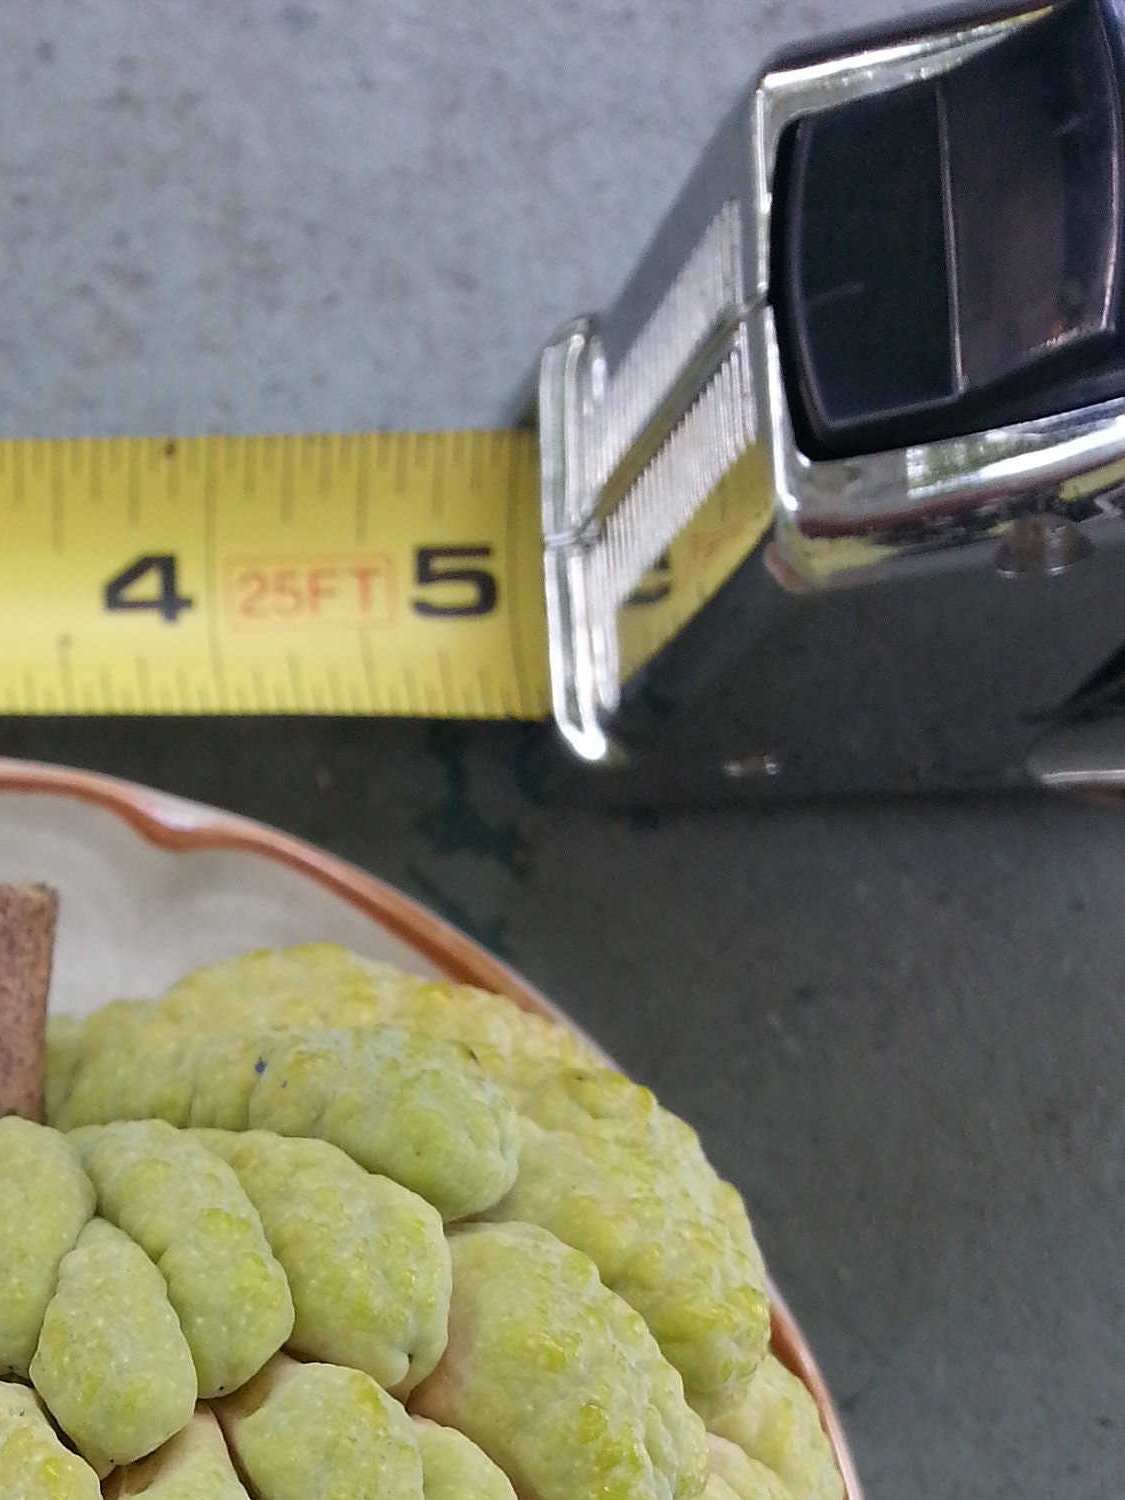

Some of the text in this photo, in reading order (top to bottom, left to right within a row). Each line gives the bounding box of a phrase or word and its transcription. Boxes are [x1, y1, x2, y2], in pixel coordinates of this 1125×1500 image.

[102, 553, 193, 623] 4
[238, 564, 379, 619] 25FT
[411, 545, 498, 619] 5
